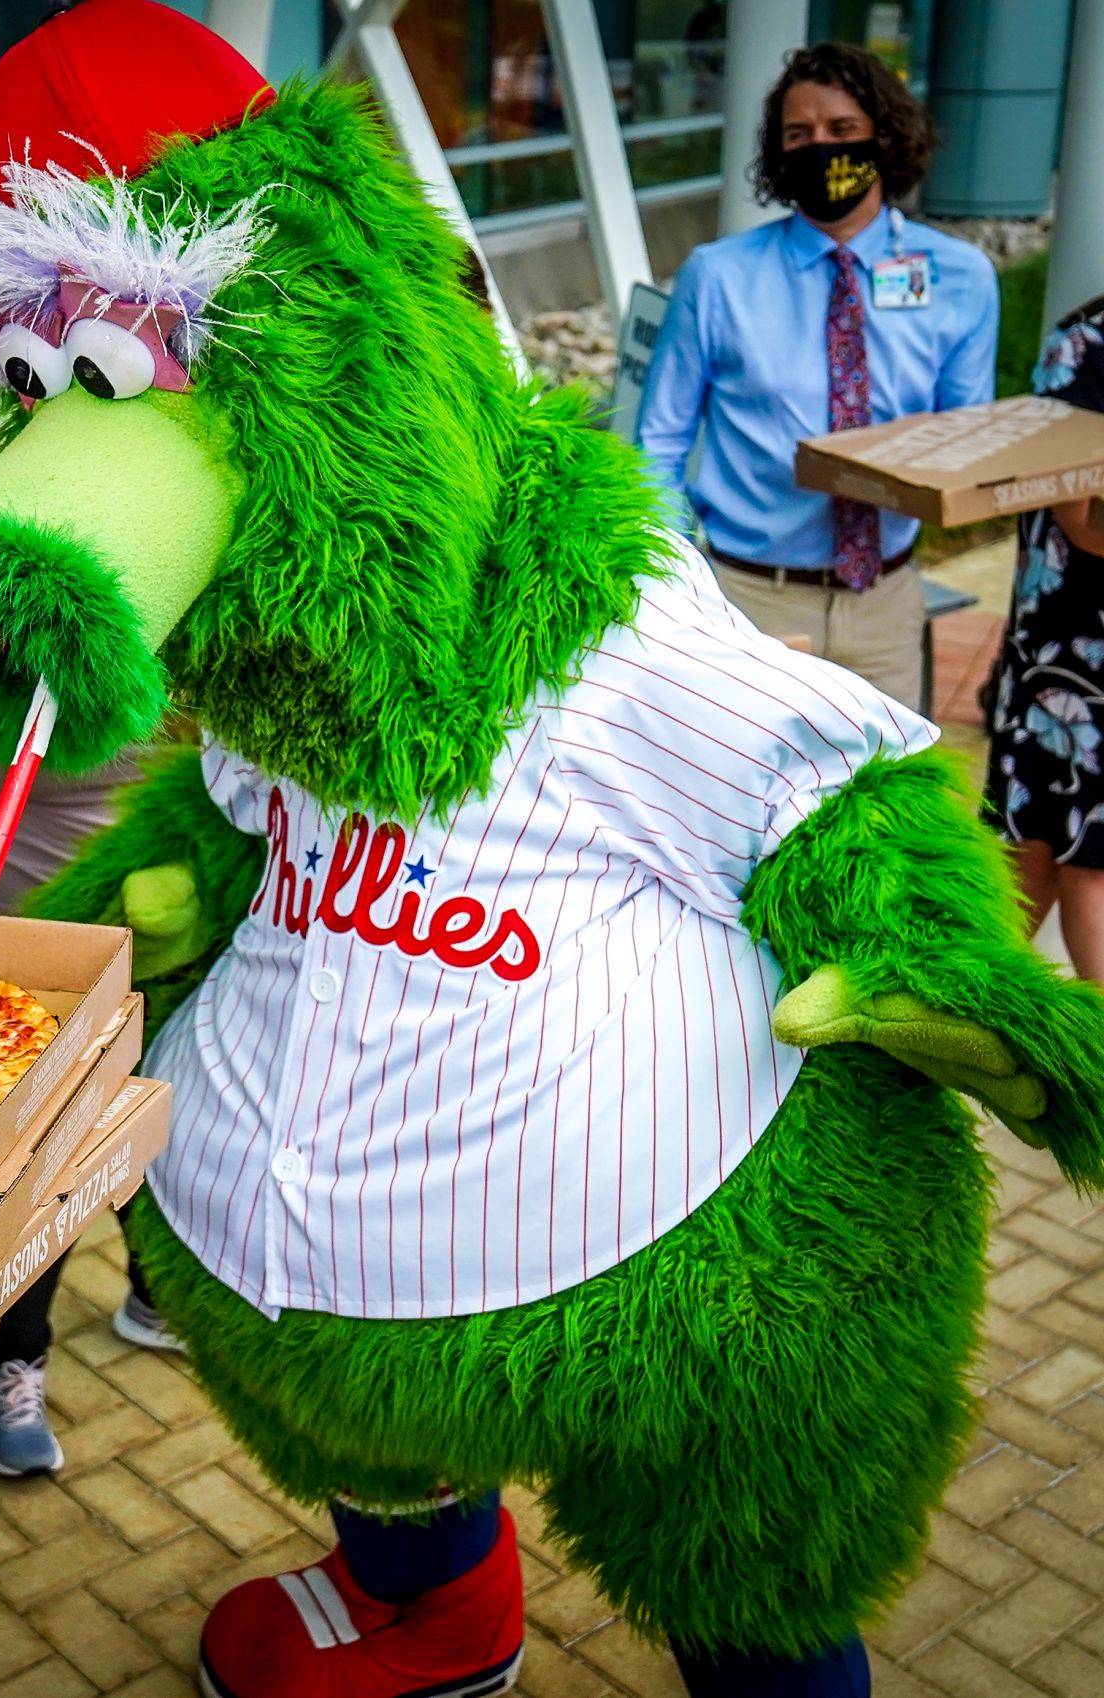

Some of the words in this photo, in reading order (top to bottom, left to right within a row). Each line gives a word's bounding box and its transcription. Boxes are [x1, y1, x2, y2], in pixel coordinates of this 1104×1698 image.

[252, 785, 541, 982] Phillies
[110, 1141, 132, 1173] SALAD
[69, 1163, 109, 1233] PIZZA
